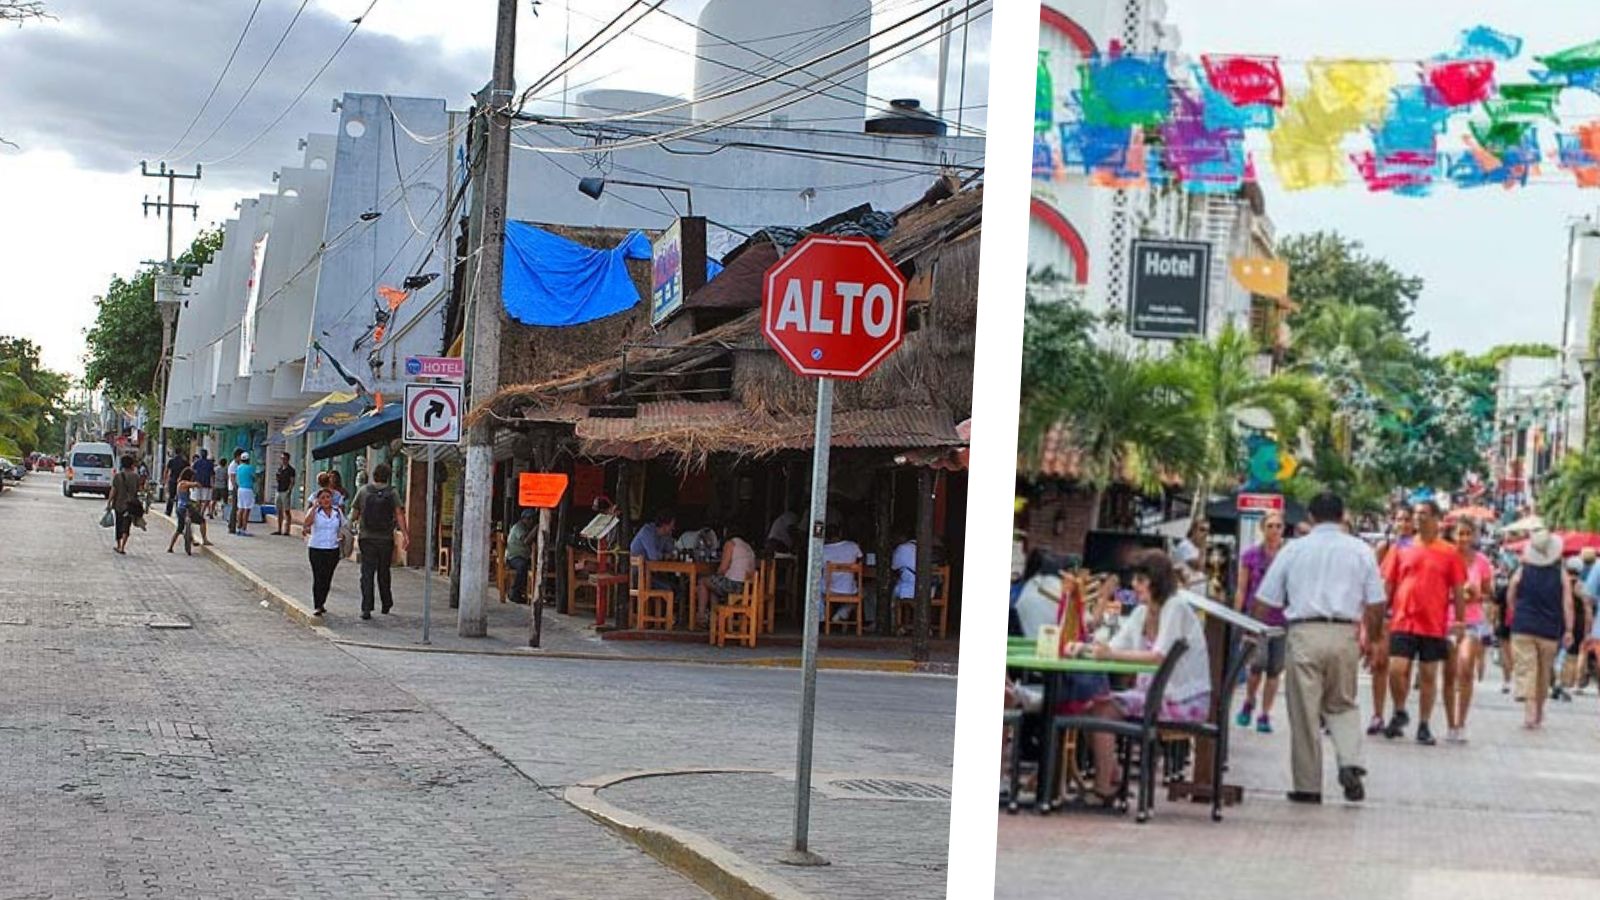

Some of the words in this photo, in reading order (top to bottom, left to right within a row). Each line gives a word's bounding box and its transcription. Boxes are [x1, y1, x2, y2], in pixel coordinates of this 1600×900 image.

[1145, 251, 1195, 277] Hotel
[775, 278, 894, 338] ALTO
[423, 362, 463, 374] HOTEL
